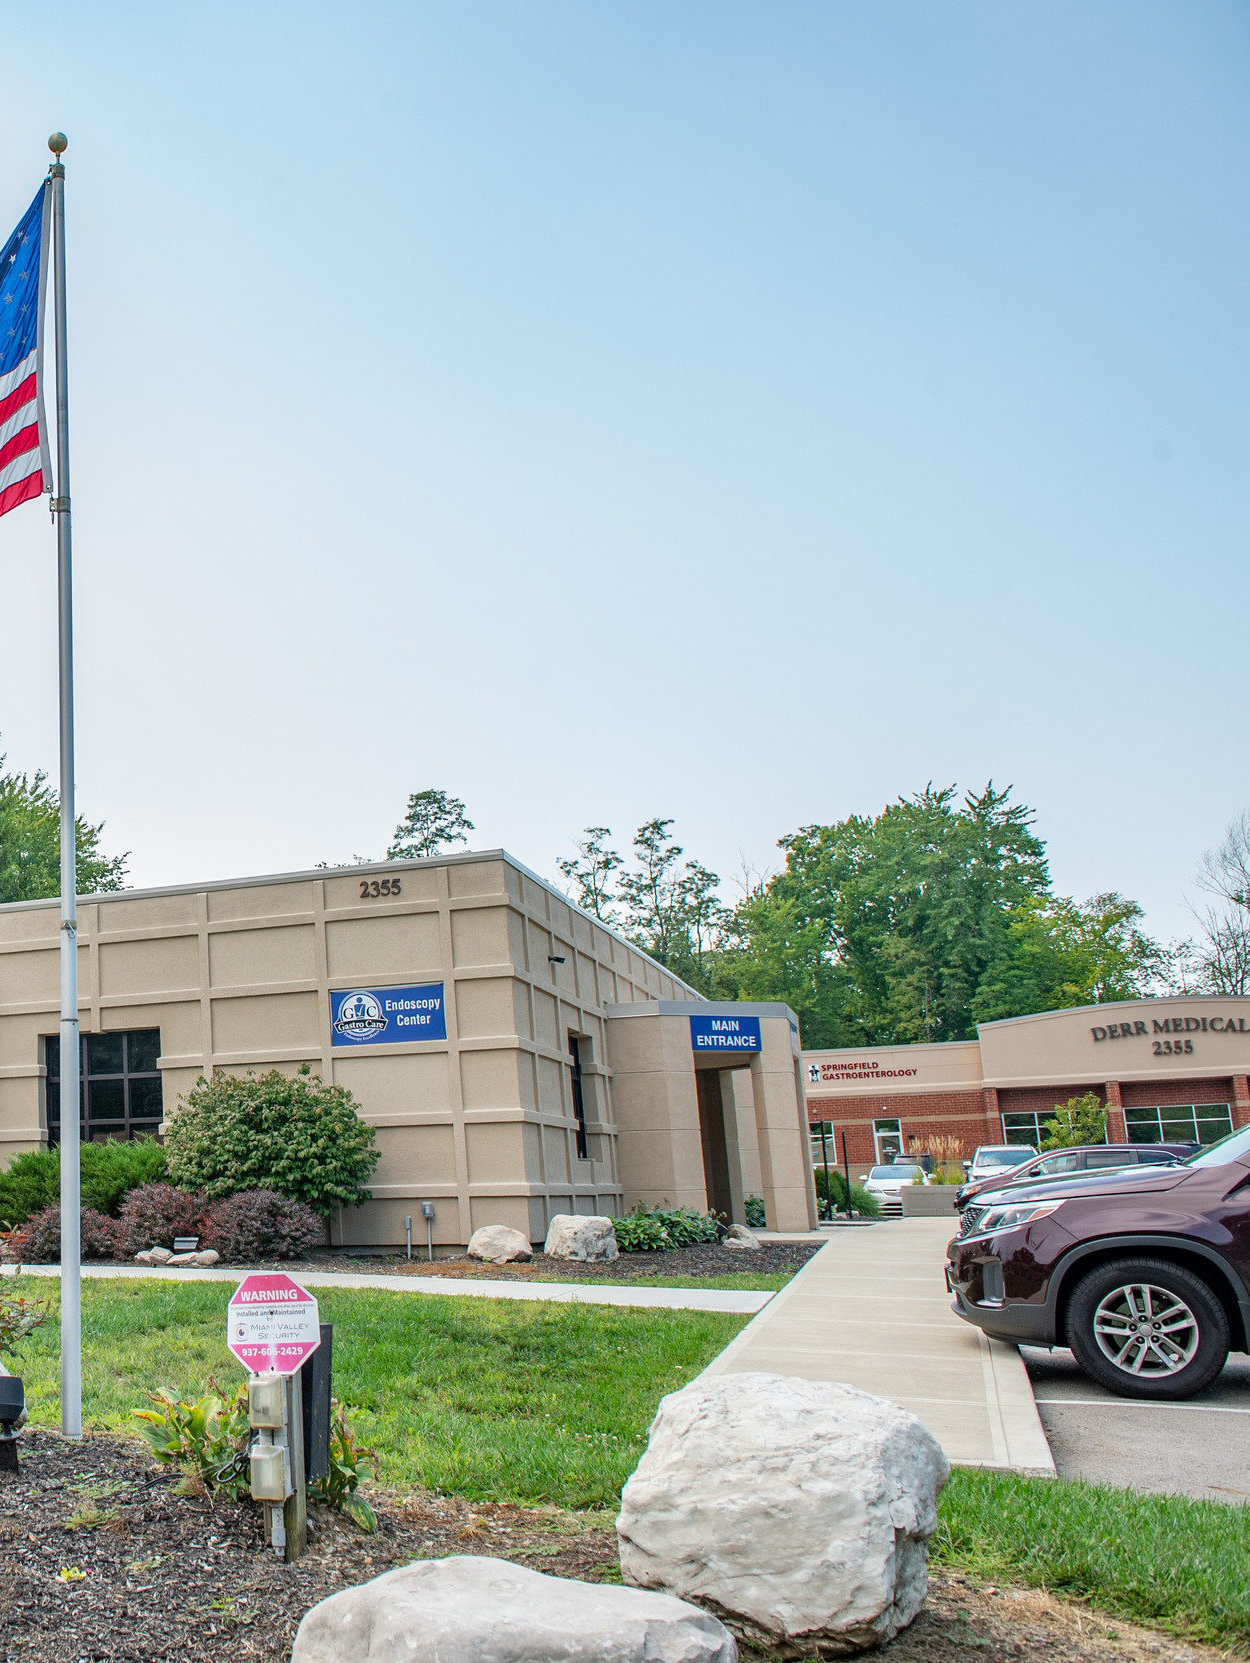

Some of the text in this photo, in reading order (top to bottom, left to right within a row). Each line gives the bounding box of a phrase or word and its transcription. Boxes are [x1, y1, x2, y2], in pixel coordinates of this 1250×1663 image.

[359, 878, 401, 898] 2355
[385, 998, 441, 1011] Endoscopy
[338, 1020, 384, 1031] Gastro Care
[397, 1015, 431, 1026] Center
[711, 1020, 740, 1031] MAIN
[1090, 1017, 1250, 1042] DERR MEDICAL
[697, 1035, 757, 1047] ENTRANCE
[1152, 1040, 1194, 1056] 2355
[821, 1062, 879, 1071] SPRINGFIELD
[822, 1069, 918, 1080] GASTROENTEROLOGY
[241, 1289, 297, 1302] WARNING
[272, 1308, 305, 1316] Maintained
